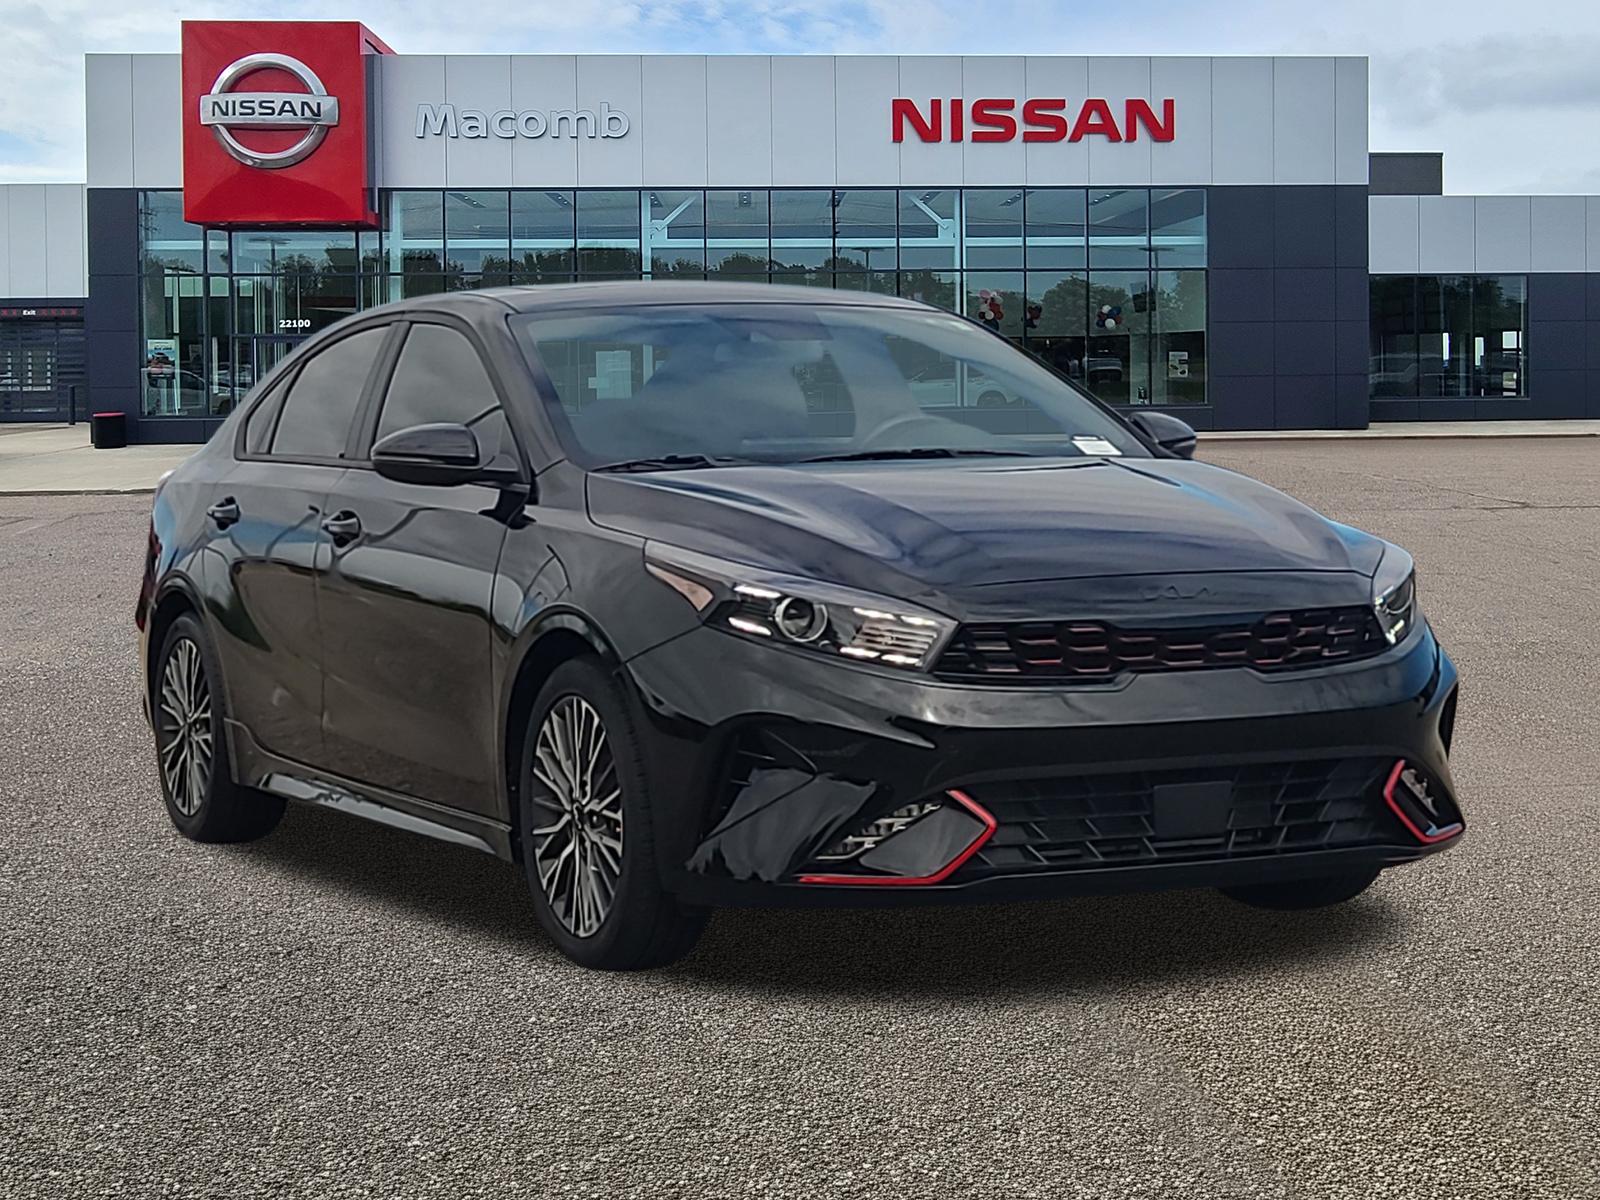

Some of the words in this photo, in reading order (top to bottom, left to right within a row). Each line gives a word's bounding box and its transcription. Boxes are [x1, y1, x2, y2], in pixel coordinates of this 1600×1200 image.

[211, 100, 321, 118] NISSAN
[415, 102, 630, 138] Macomb
[892, 98, 1175, 143] NISSAN
[279, 319, 311, 328] 22100
